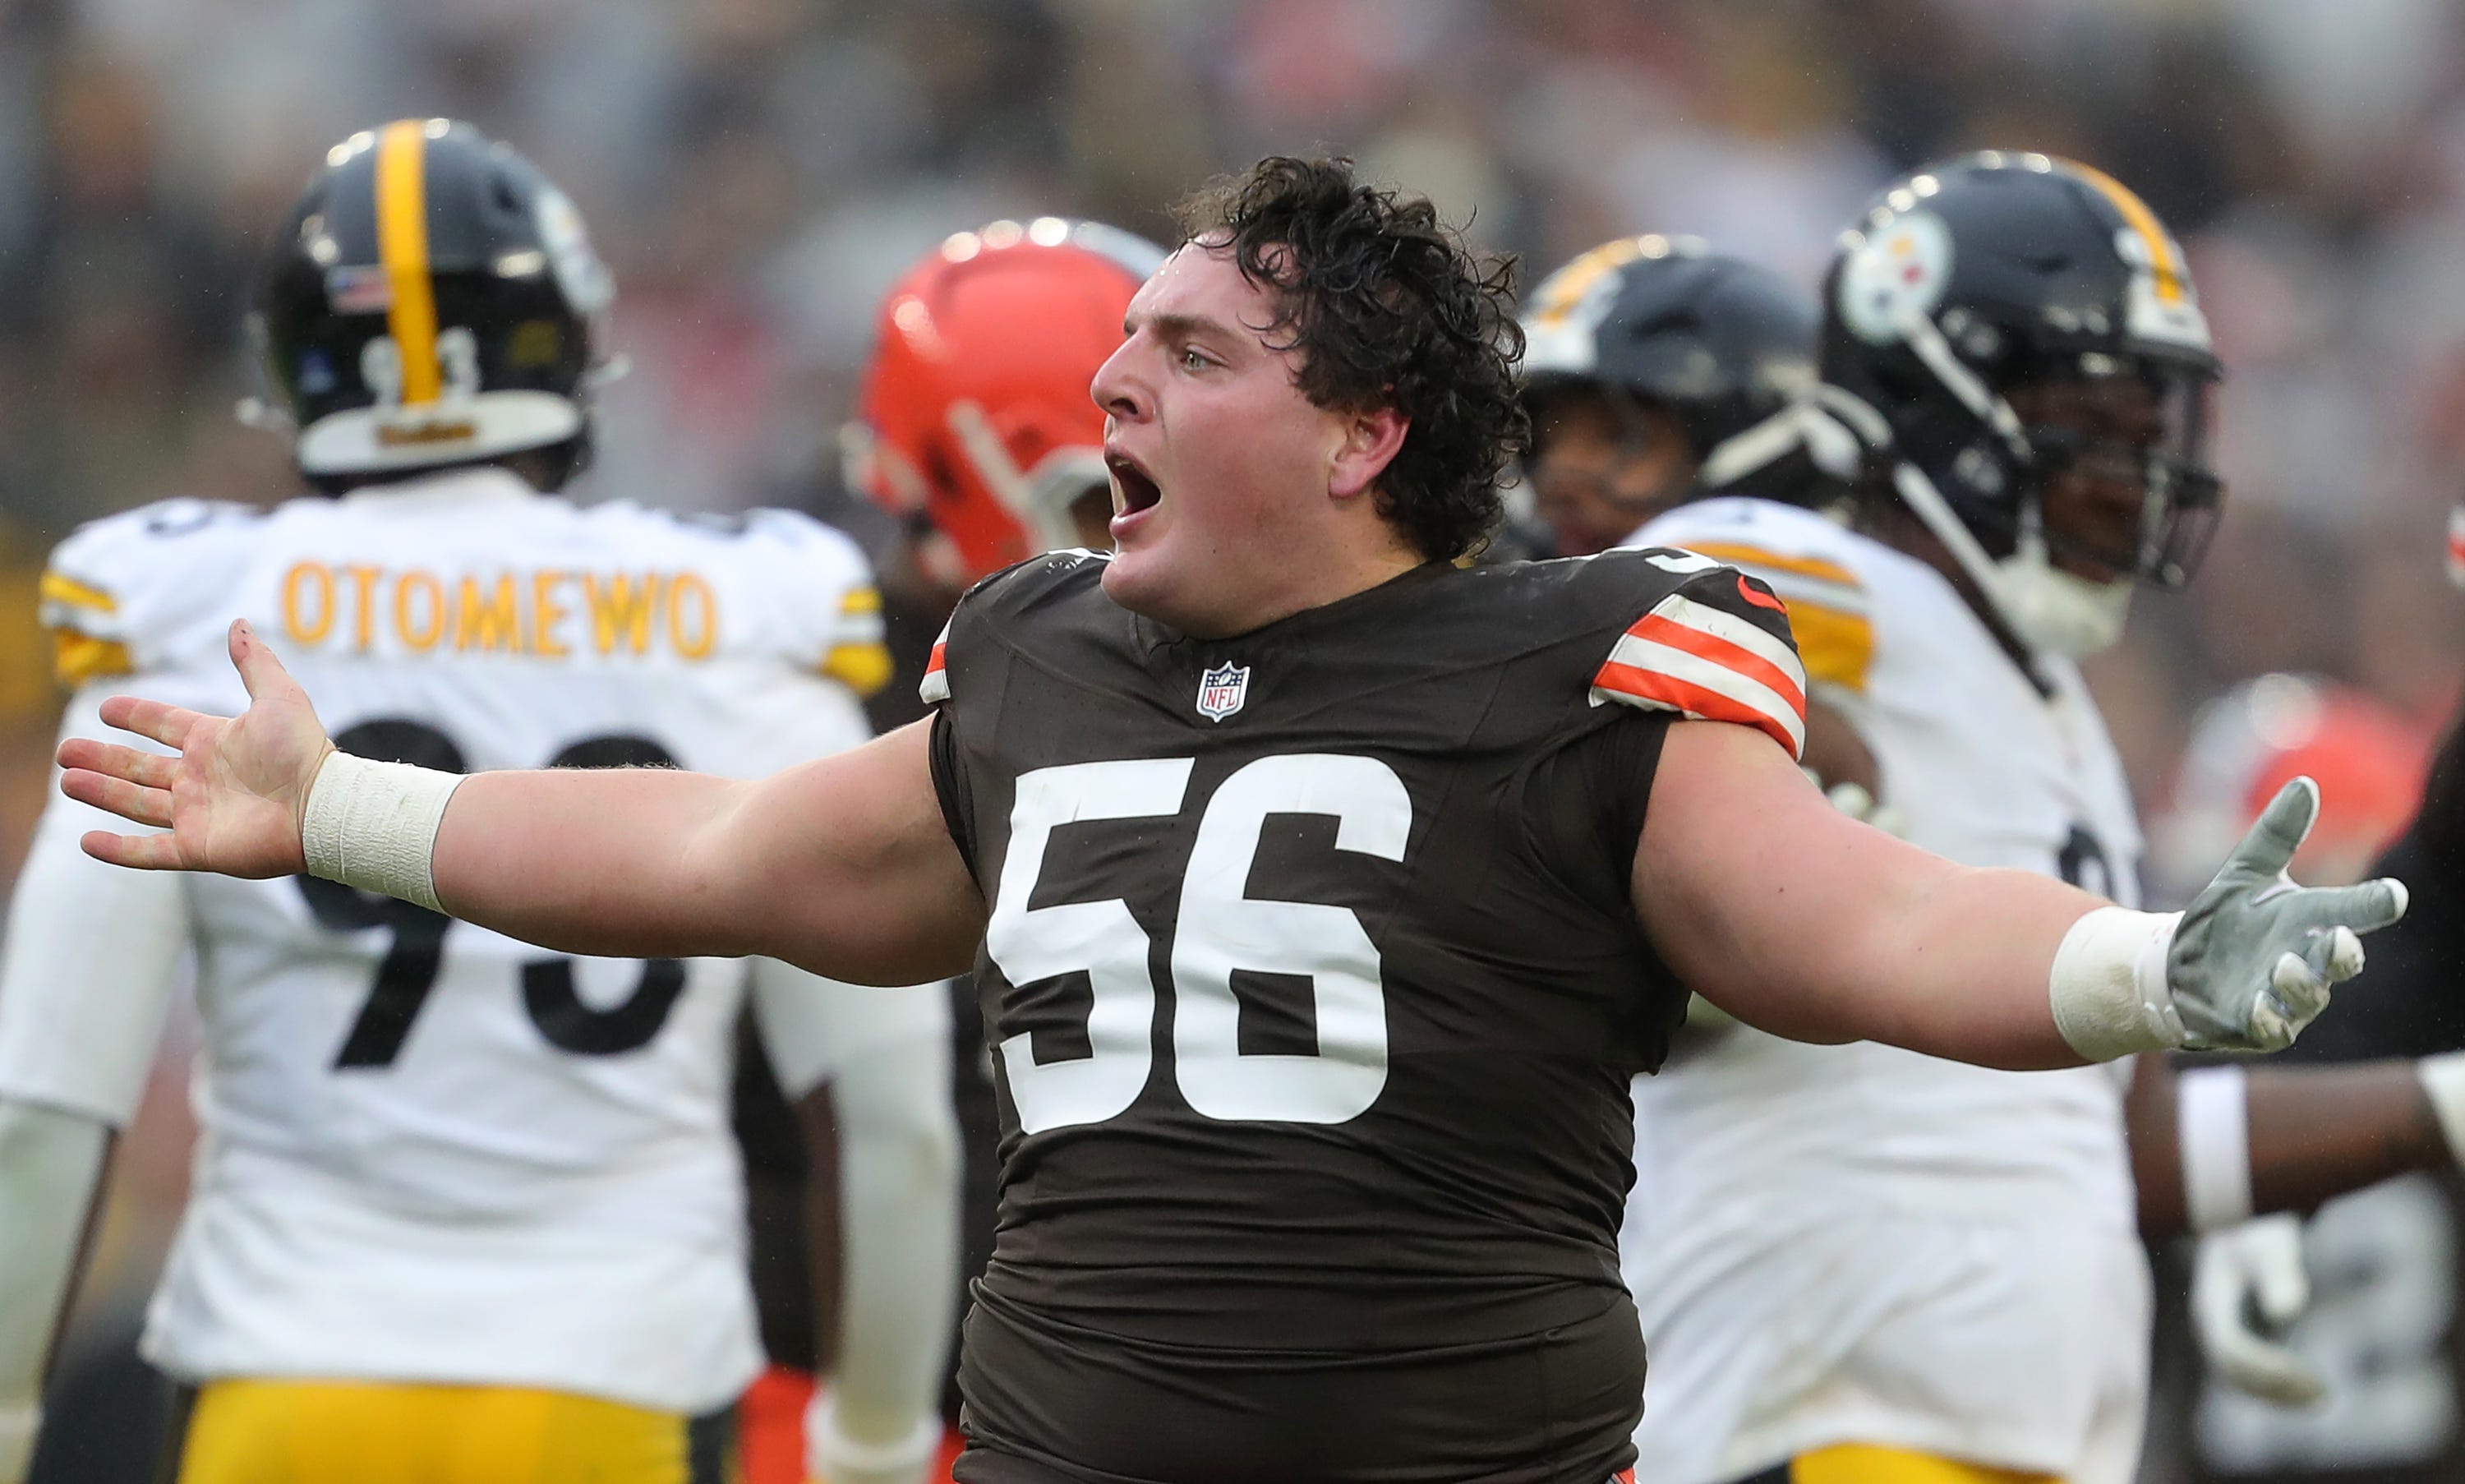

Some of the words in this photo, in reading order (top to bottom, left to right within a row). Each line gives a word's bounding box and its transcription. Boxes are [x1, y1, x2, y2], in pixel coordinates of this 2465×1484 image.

[283, 562, 717, 660] OTOMEWO
[1205, 689, 1236, 710] NFL
[987, 753, 1412, 1136] 56
